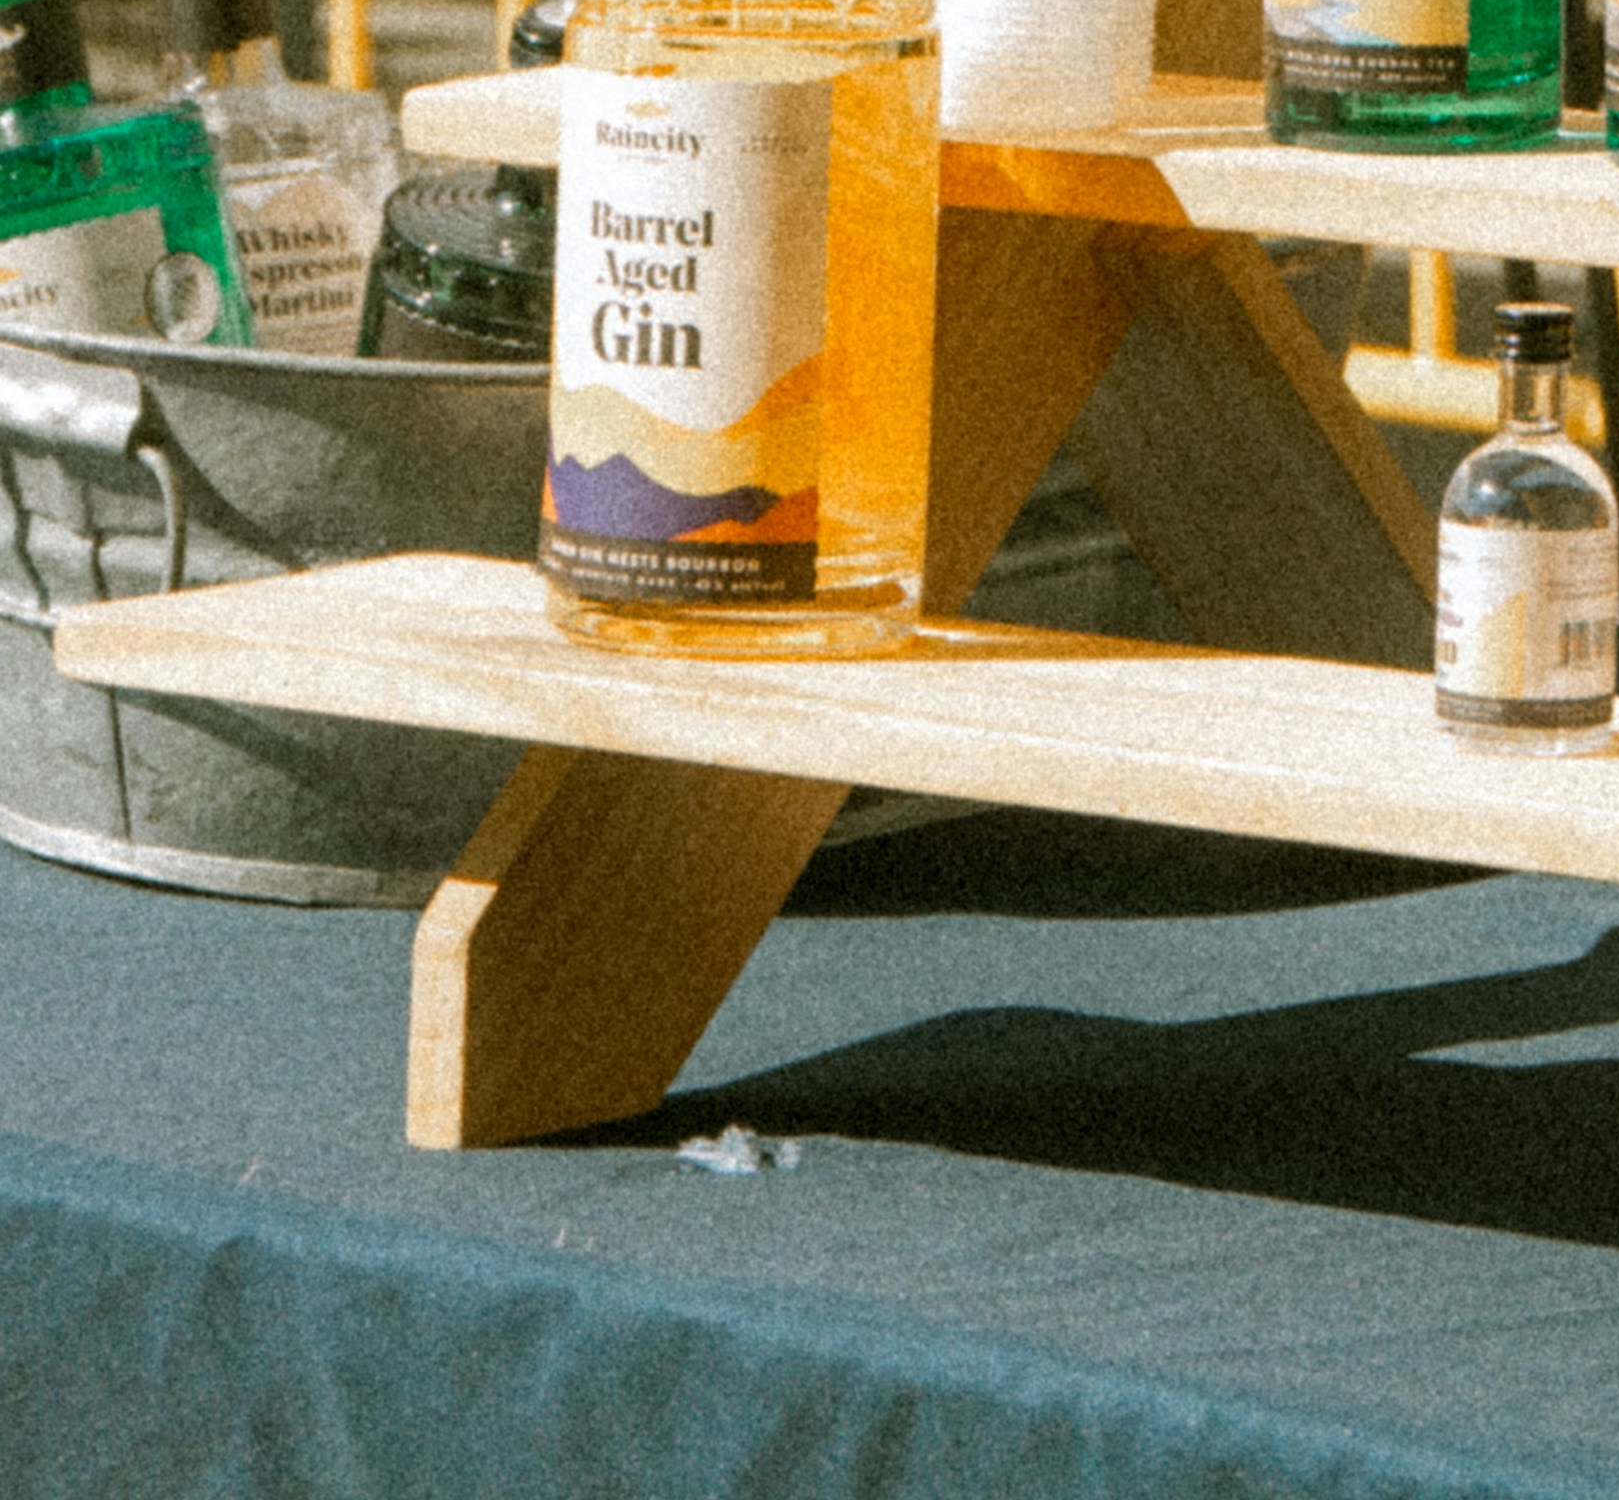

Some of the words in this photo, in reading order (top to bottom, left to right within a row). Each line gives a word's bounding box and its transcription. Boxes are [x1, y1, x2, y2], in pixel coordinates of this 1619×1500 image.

[595, 120, 706, 159] Raincity
[235, 221, 349, 255] Whisky
[590, 198, 715, 249] Barrel
[250, 254, 363, 292] spresso
[595, 248, 698, 296] Aged
[590, 298, 704, 371] Gin
